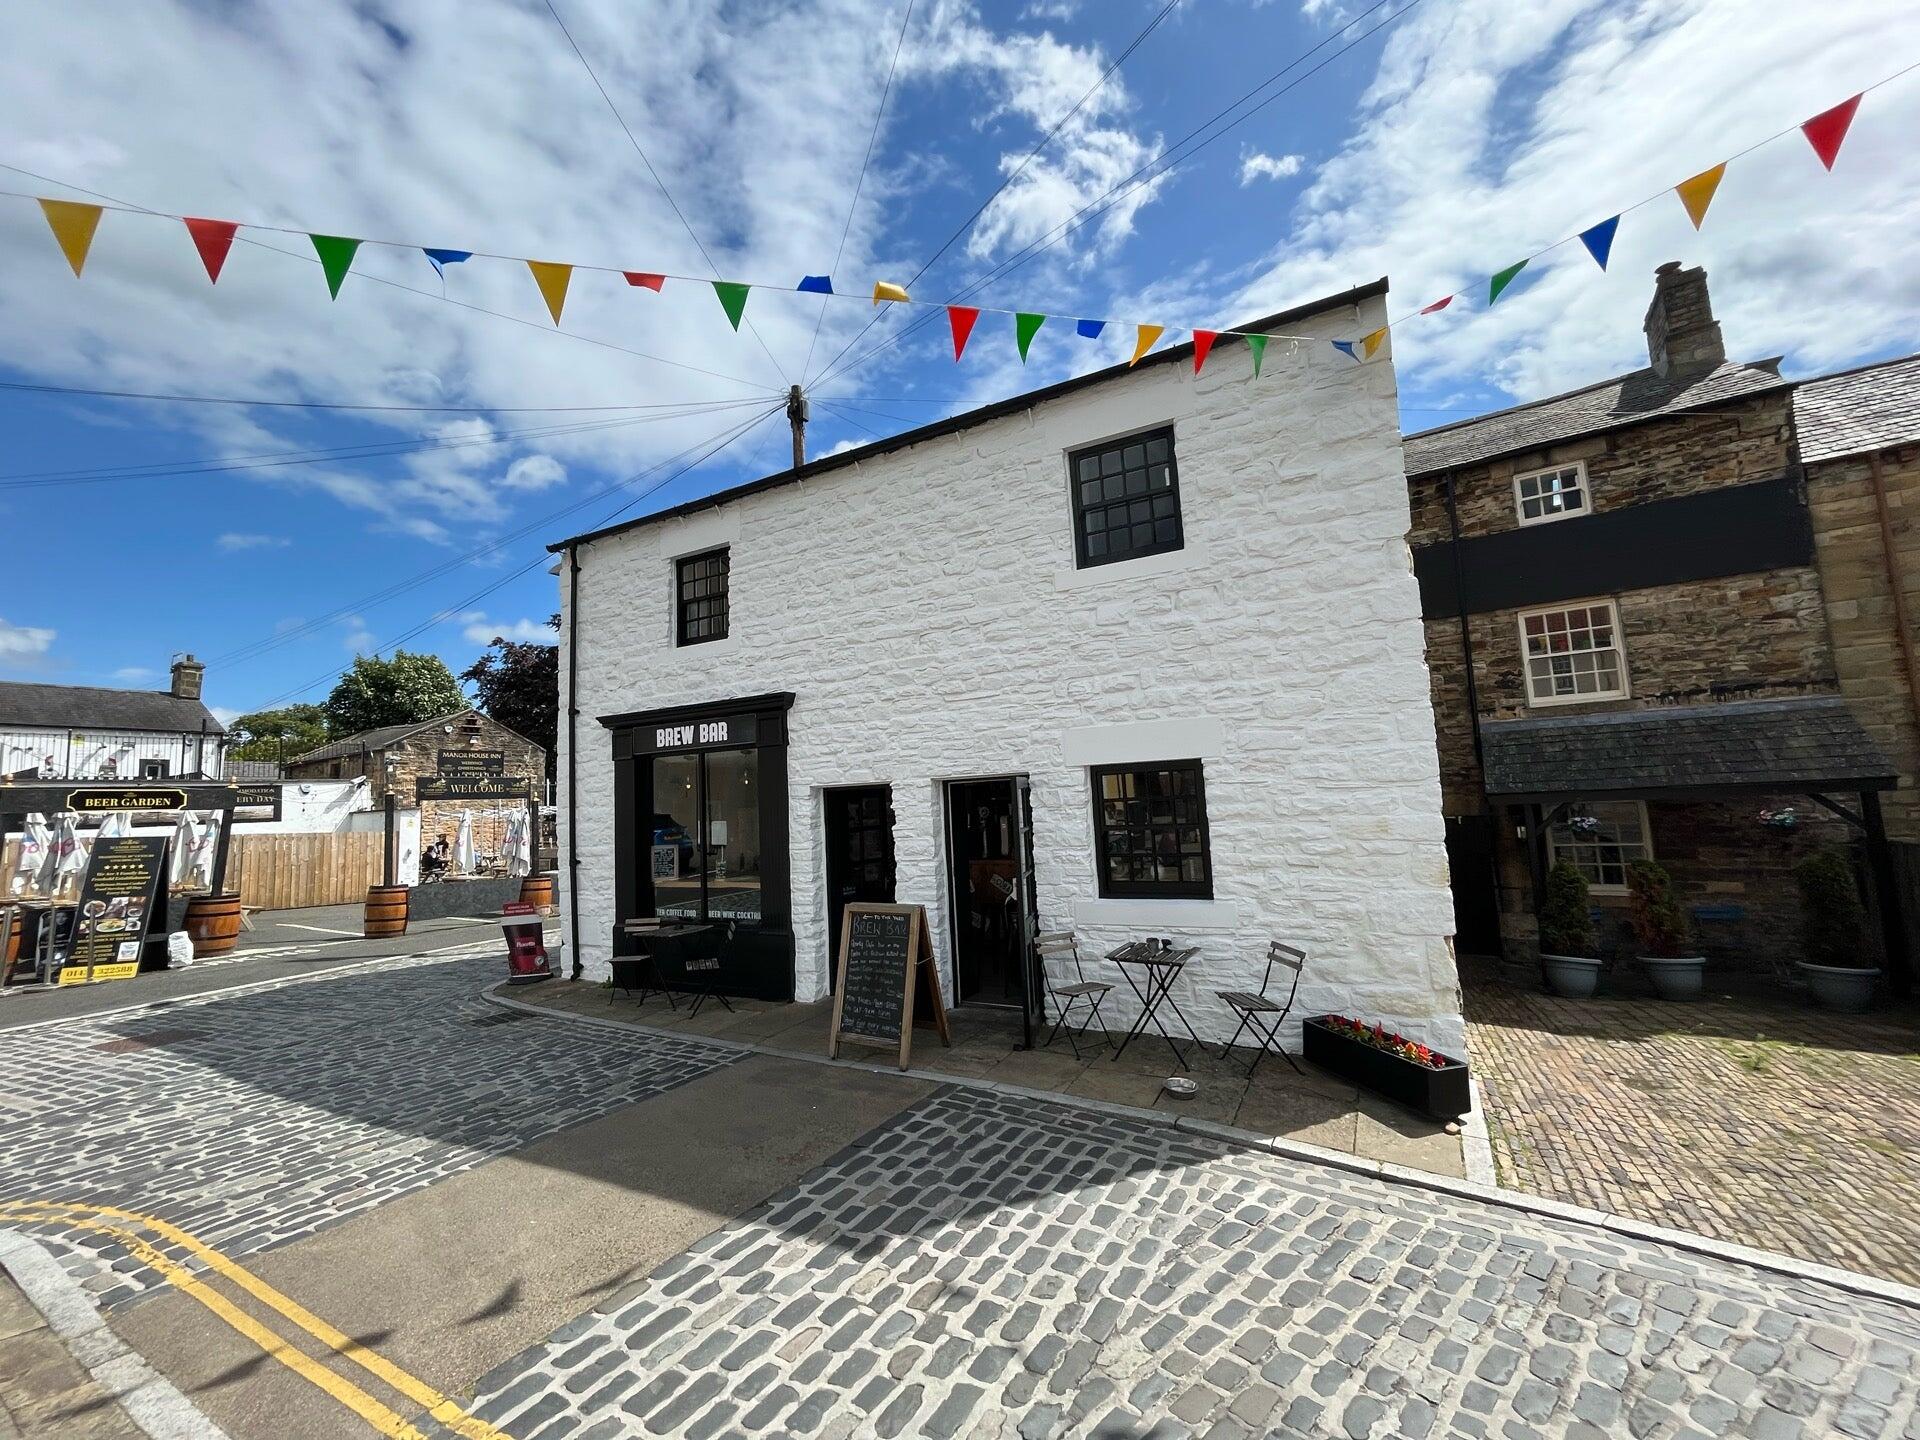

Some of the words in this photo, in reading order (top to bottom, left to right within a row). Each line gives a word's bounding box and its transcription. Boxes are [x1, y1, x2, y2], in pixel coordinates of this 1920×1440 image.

[656, 725, 694, 748] BREW
[699, 721, 728, 743] BAR
[450, 784, 505, 793] WELCOME
[85, 798, 118, 807] BEER
[121, 797, 171, 807] GARDEN
[666, 908, 683, 917] COFFEE
[684, 909, 697, 917] FOOD
[708, 910, 720, 918] BEER
[722, 911, 736, 919] WINE
[853, 915, 881, 936] BREW
[886, 920, 907, 935] BAR
